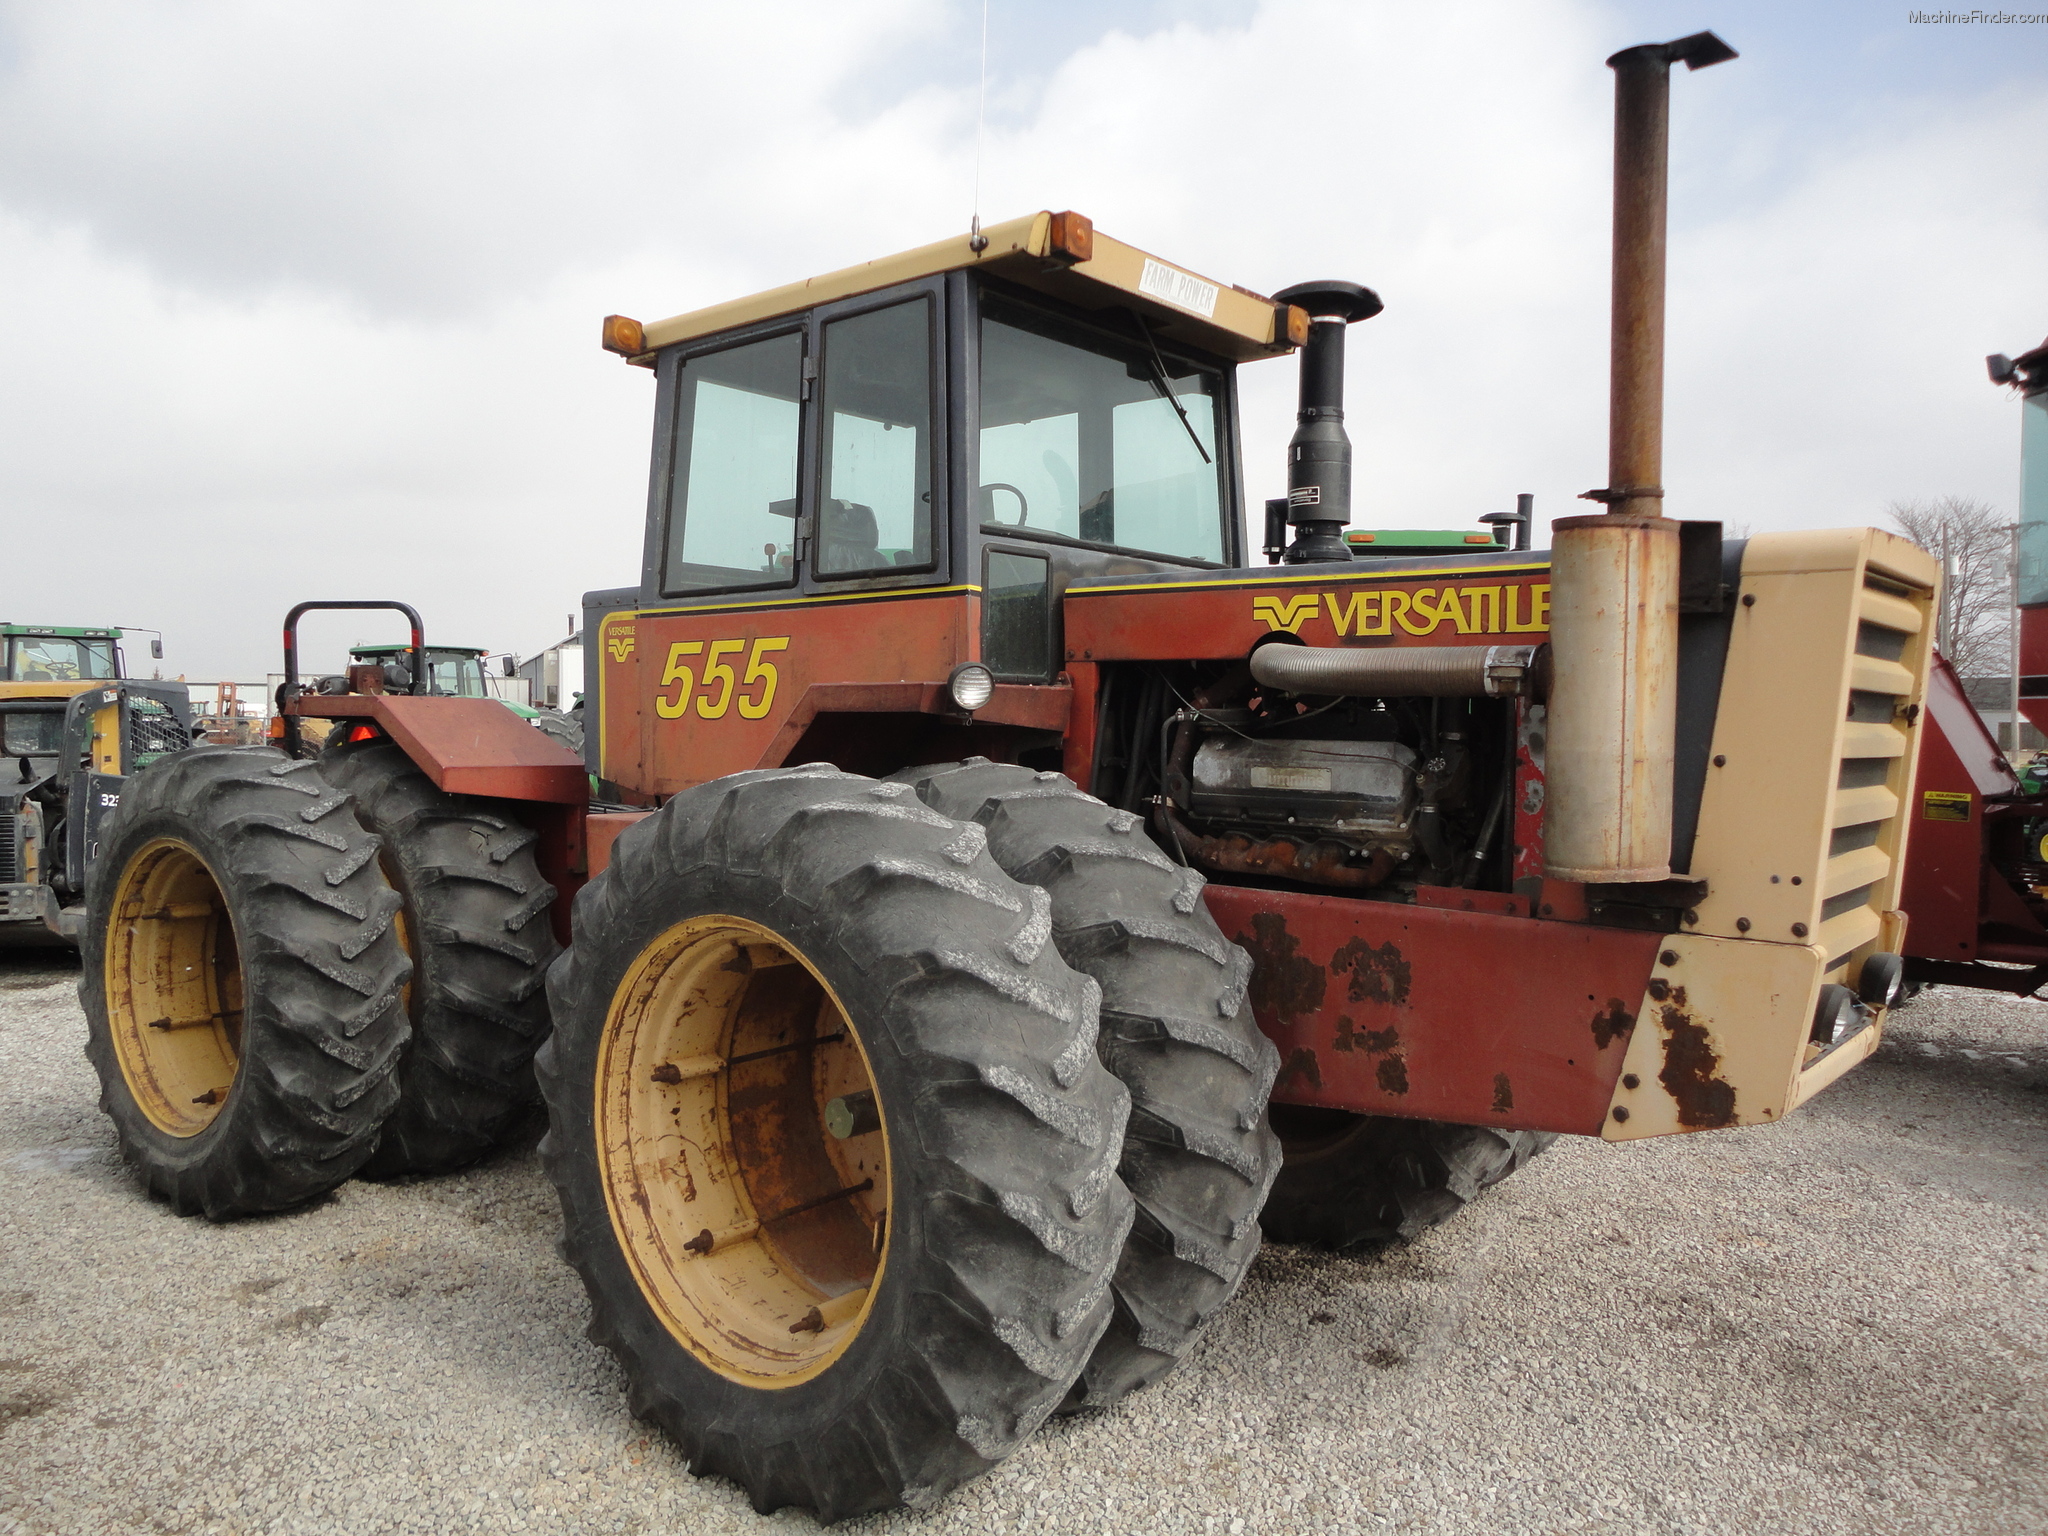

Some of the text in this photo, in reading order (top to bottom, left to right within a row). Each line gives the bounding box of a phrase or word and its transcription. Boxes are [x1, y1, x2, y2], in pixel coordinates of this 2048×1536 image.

[1144, 262, 1214, 310] FARM POWER
[608, 625, 636, 636] VERSATILE
[1322, 583, 1550, 636] VERSATILE
[655, 635, 791, 720] 555
[1255, 769, 1325, 788] ummins
